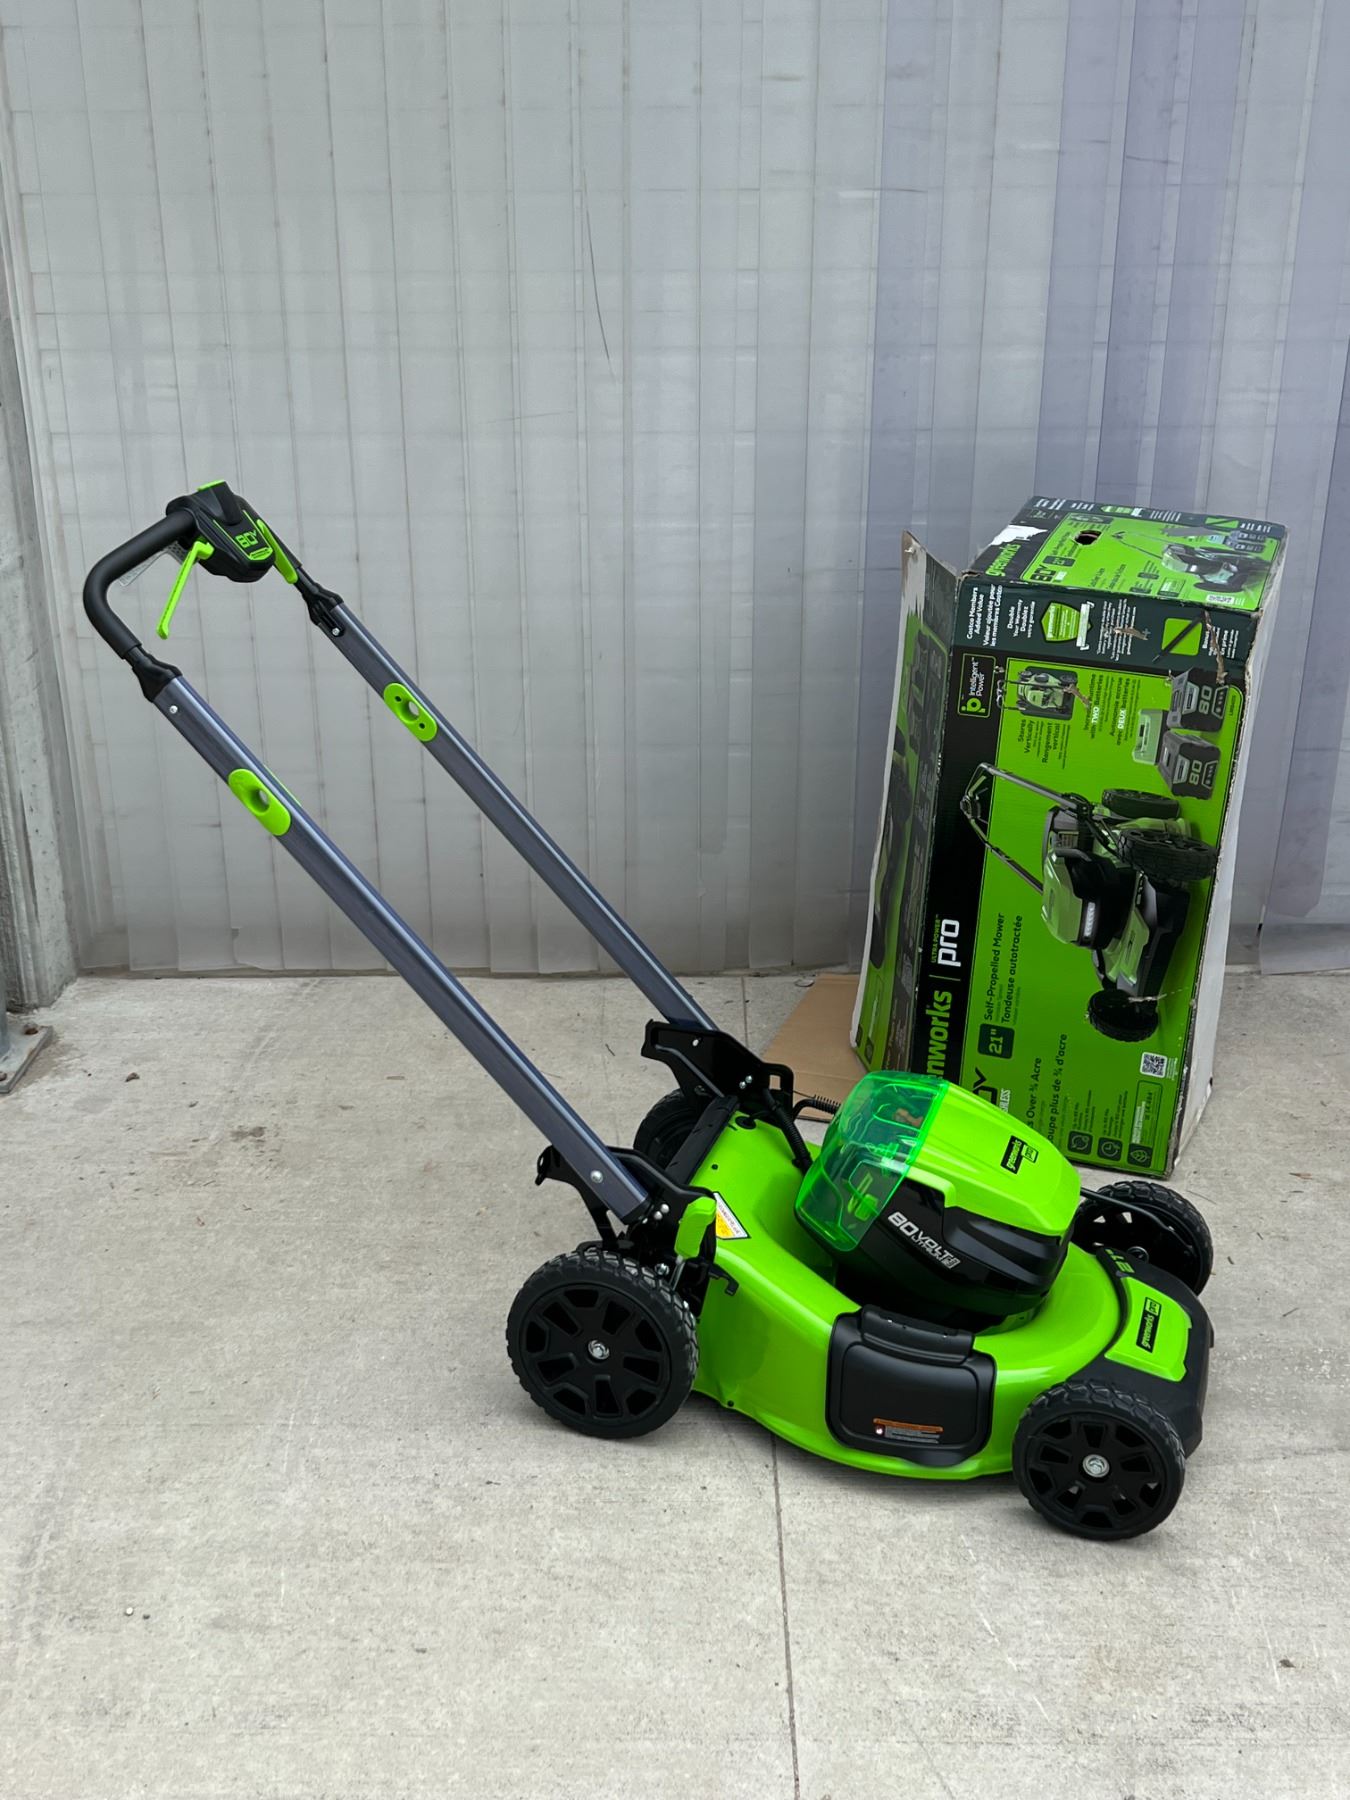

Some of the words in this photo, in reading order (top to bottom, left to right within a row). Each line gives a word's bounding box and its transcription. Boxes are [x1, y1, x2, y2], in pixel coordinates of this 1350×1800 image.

[235, 530, 258, 548] 80V
[985, 544, 1021, 576] greenworks
[968, 587, 978, 615] Members
[994, 585, 1003, 606] Costco
[992, 608, 1001, 636] membres
[1007, 606, 1015, 628] Double
[1015, 600, 1023, 624] Warranty
[1020, 606, 1028, 631] Doublez
[967, 617, 975, 639] Costco
[983, 625, 991, 645] Valeur
[969, 661, 979, 696] Intelligent
[976, 672, 984, 697] Power
[1094, 675, 1103, 705] Batteries
[1199, 686, 1212, 714] 80
[1091, 706, 1099, 724] TWO
[1109, 701, 1119, 736] Autonomie
[1118, 709, 1126, 729] DEUX
[1018, 719, 1026, 742] Stores
[1024, 720, 1034, 753] Vertically
[1042, 722, 1053, 763] Rangement
[1052, 723, 1060, 750] vertical
[1190, 760, 1202, 785] 80
[933, 919, 941, 942] POWER
[937, 919, 961, 967] pro
[984, 949, 1000, 1020] Self-Propelled
[993, 913, 1005, 947] Mower
[1001, 977, 1015, 1023] Tondeuse
[1008, 915, 1023, 975] autotractée
[926, 991, 952, 1080] nworks
[989, 1029, 1003, 1055] 21"
[1055, 1034, 1068, 1065] d'acre
[1030, 1058, 1042, 1081] Acre
[1051, 1079, 1062, 1091] de
[1026, 1094, 1037, 1118] Over
[1049, 1093, 1061, 1114] plus
[1046, 1116, 1059, 1144] oupe
[888, 1211, 919, 1236] 80
[917, 1231, 956, 1261] VOLT
[1141, 1314, 1155, 1349] greenworks
[1149, 1301, 1159, 1315] pro
